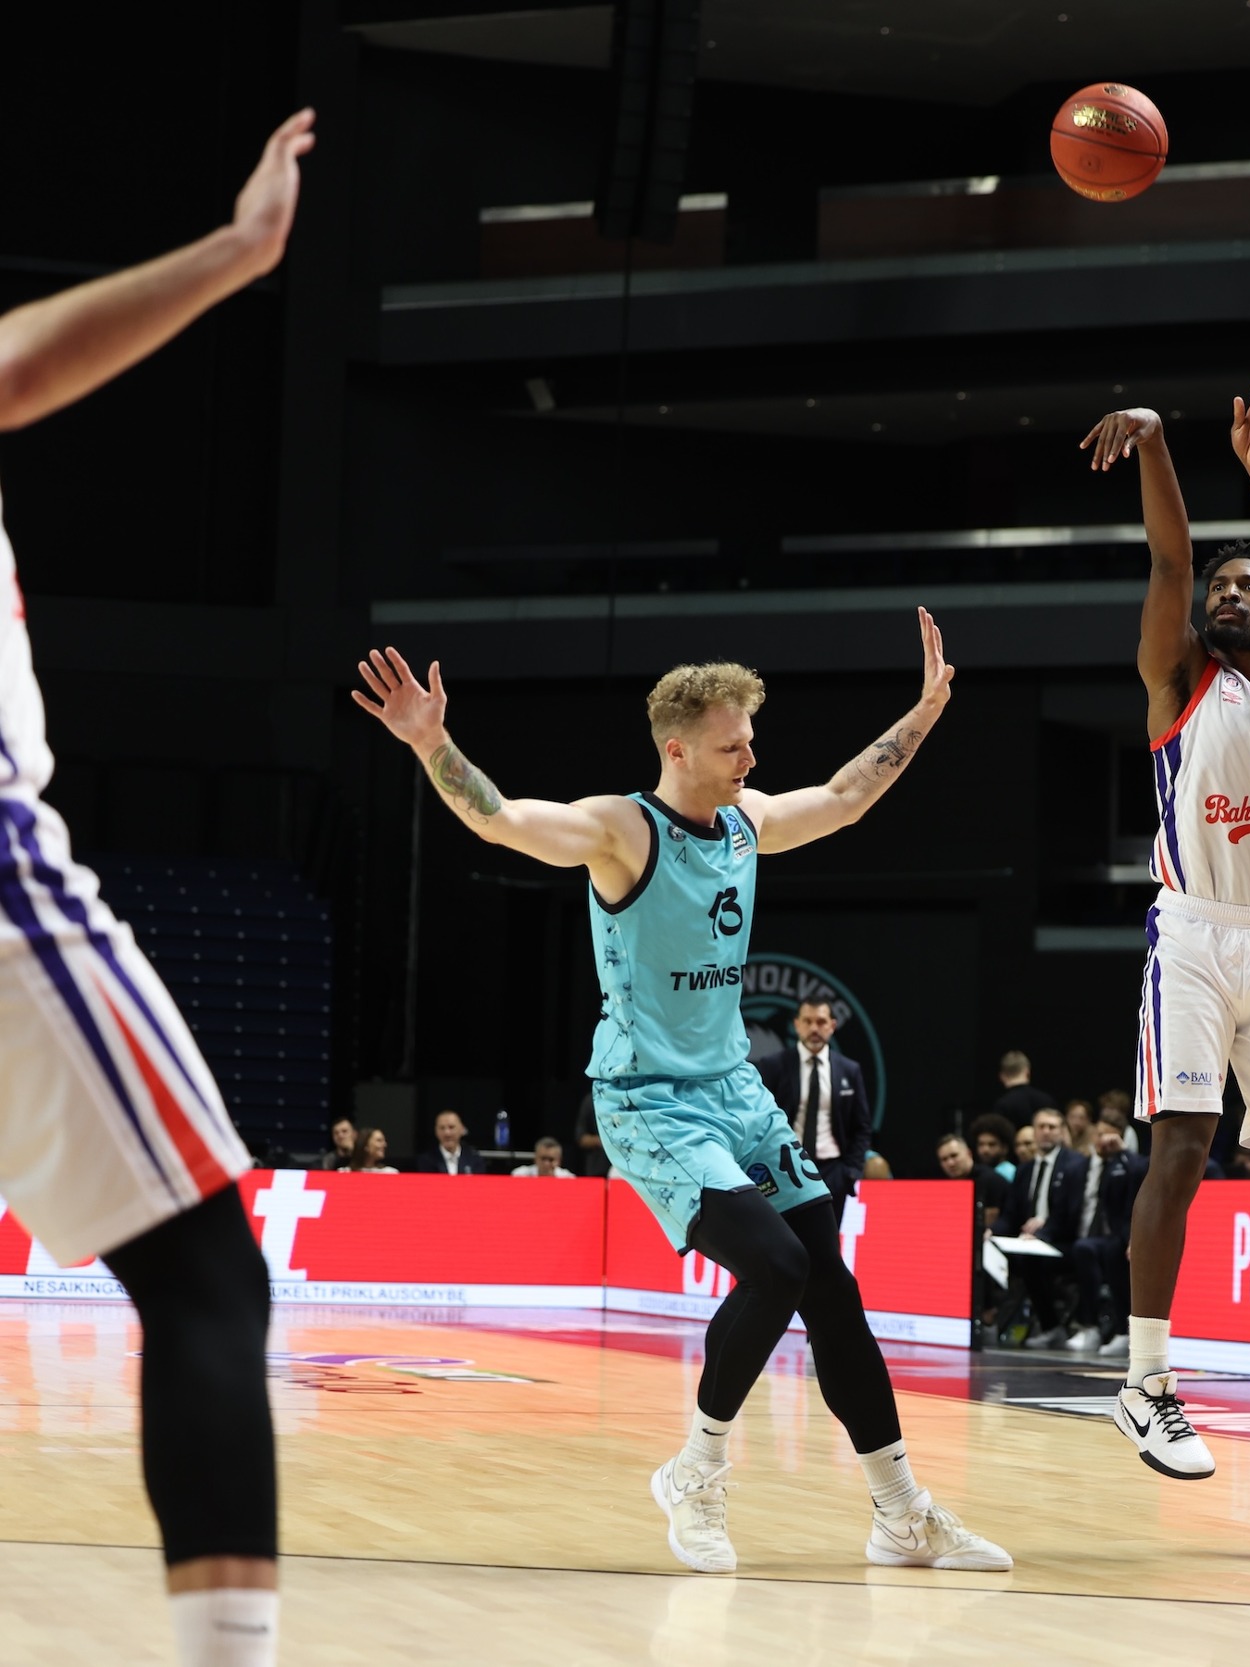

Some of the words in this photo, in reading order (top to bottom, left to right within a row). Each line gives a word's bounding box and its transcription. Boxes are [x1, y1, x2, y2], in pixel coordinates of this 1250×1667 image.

[708, 886, 743, 940] 13
[1190, 1071, 1212, 1083] BAU
[779, 1140, 823, 1189] 13
[23, 1280, 129, 1296] NESAIKINGA
[269, 1285, 326, 1299] UKELTI
